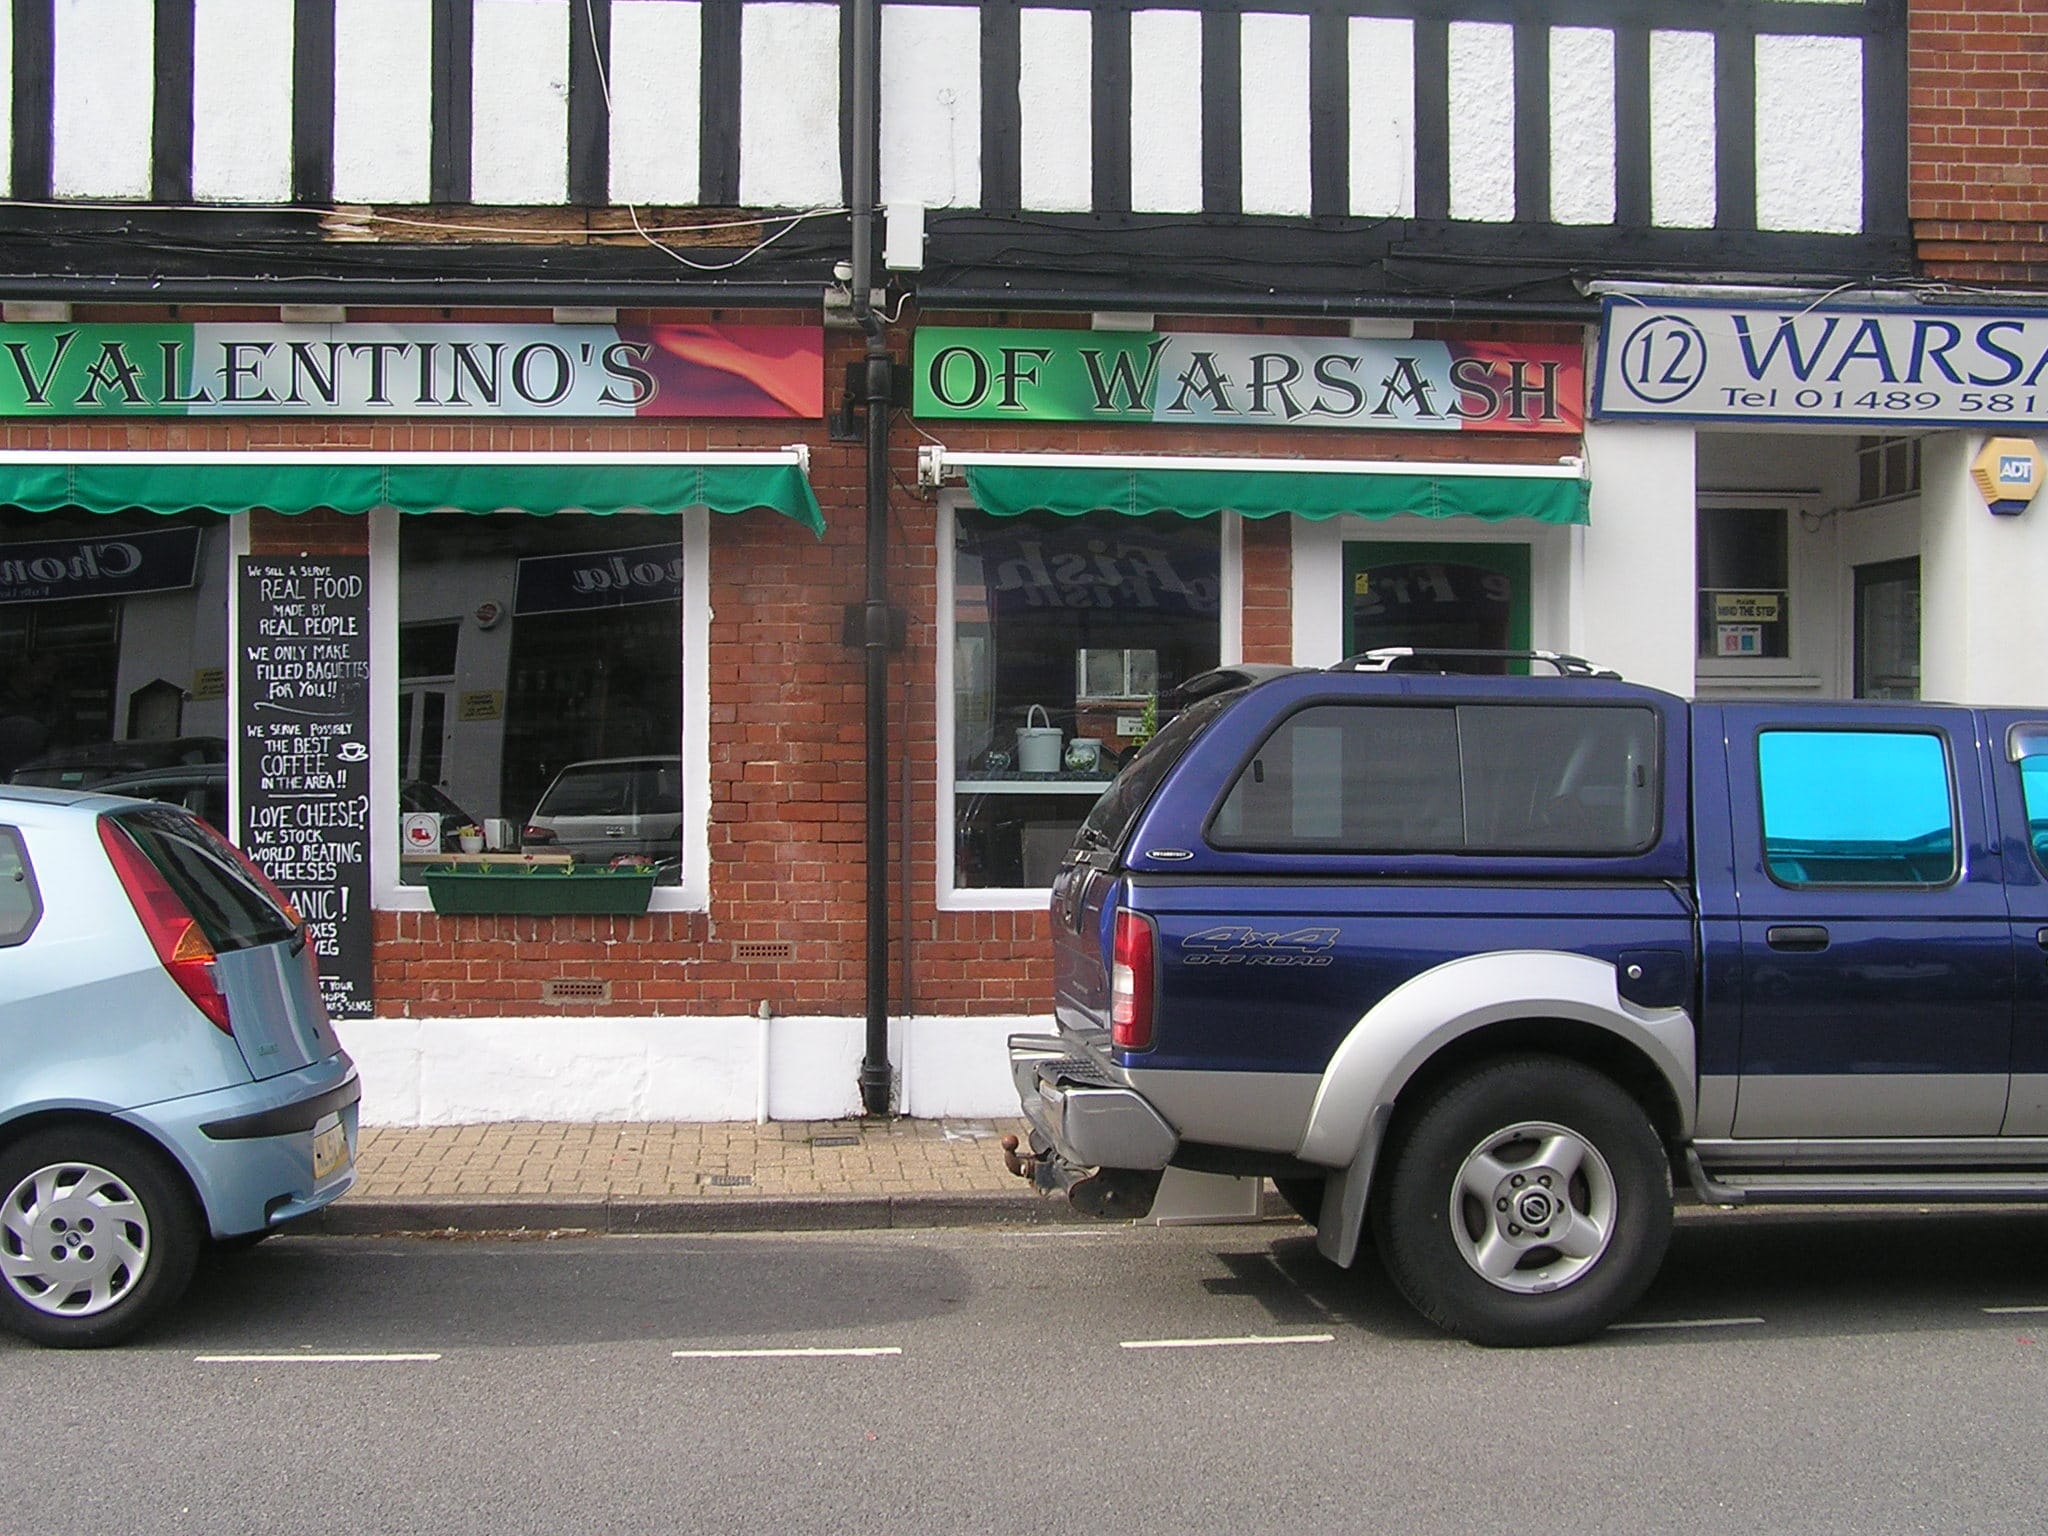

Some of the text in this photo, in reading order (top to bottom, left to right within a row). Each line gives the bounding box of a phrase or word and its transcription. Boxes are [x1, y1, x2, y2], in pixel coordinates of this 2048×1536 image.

[1638, 329, 1691, 384] 12
[3, 329, 660, 409] VALENTINO'S
[929, 335, 1566, 425] OF WARSASH
[1720, 387, 2048, 412] Tel 01489 581
[2000, 461, 2032, 478] ADT
[300, 566, 331, 577] SERVE
[261, 575, 362, 602] REAL FOOD
[273, 603, 326, 617] MADE BY
[1739, 606, 1755, 616] THE
[1756, 606, 1776, 616] STEP
[259, 616, 359, 636] REAL PEOPLE
[247, 643, 350, 661] WE ONLY MAKE
[257, 661, 369, 680] FILLED BAGUETTES
[299, 681, 337, 699] YOU!!
[247, 724, 264, 737] WE
[269, 723, 302, 736] SERVE
[264, 736, 332, 754] THE BEST
[261, 753, 329, 776] COFFEE
[261, 777, 274, 789] IN
[276, 776, 303, 789] THE
[250, 795, 369, 829] LOVE CHEESE?
[254, 828, 323, 844] WE STOCK
[247, 842, 362, 863] WORLD BEATING
[263, 862, 338, 880] CHEESES
[290, 886, 349, 922] ANIC!
[306, 922, 337, 939] XES
[1181, 926, 1340, 953] 4x4
[1183, 953, 1334, 966] OFF ROAD
[329, 981, 354, 992] YOUR
[320, 992, 347, 1003] HOPS
